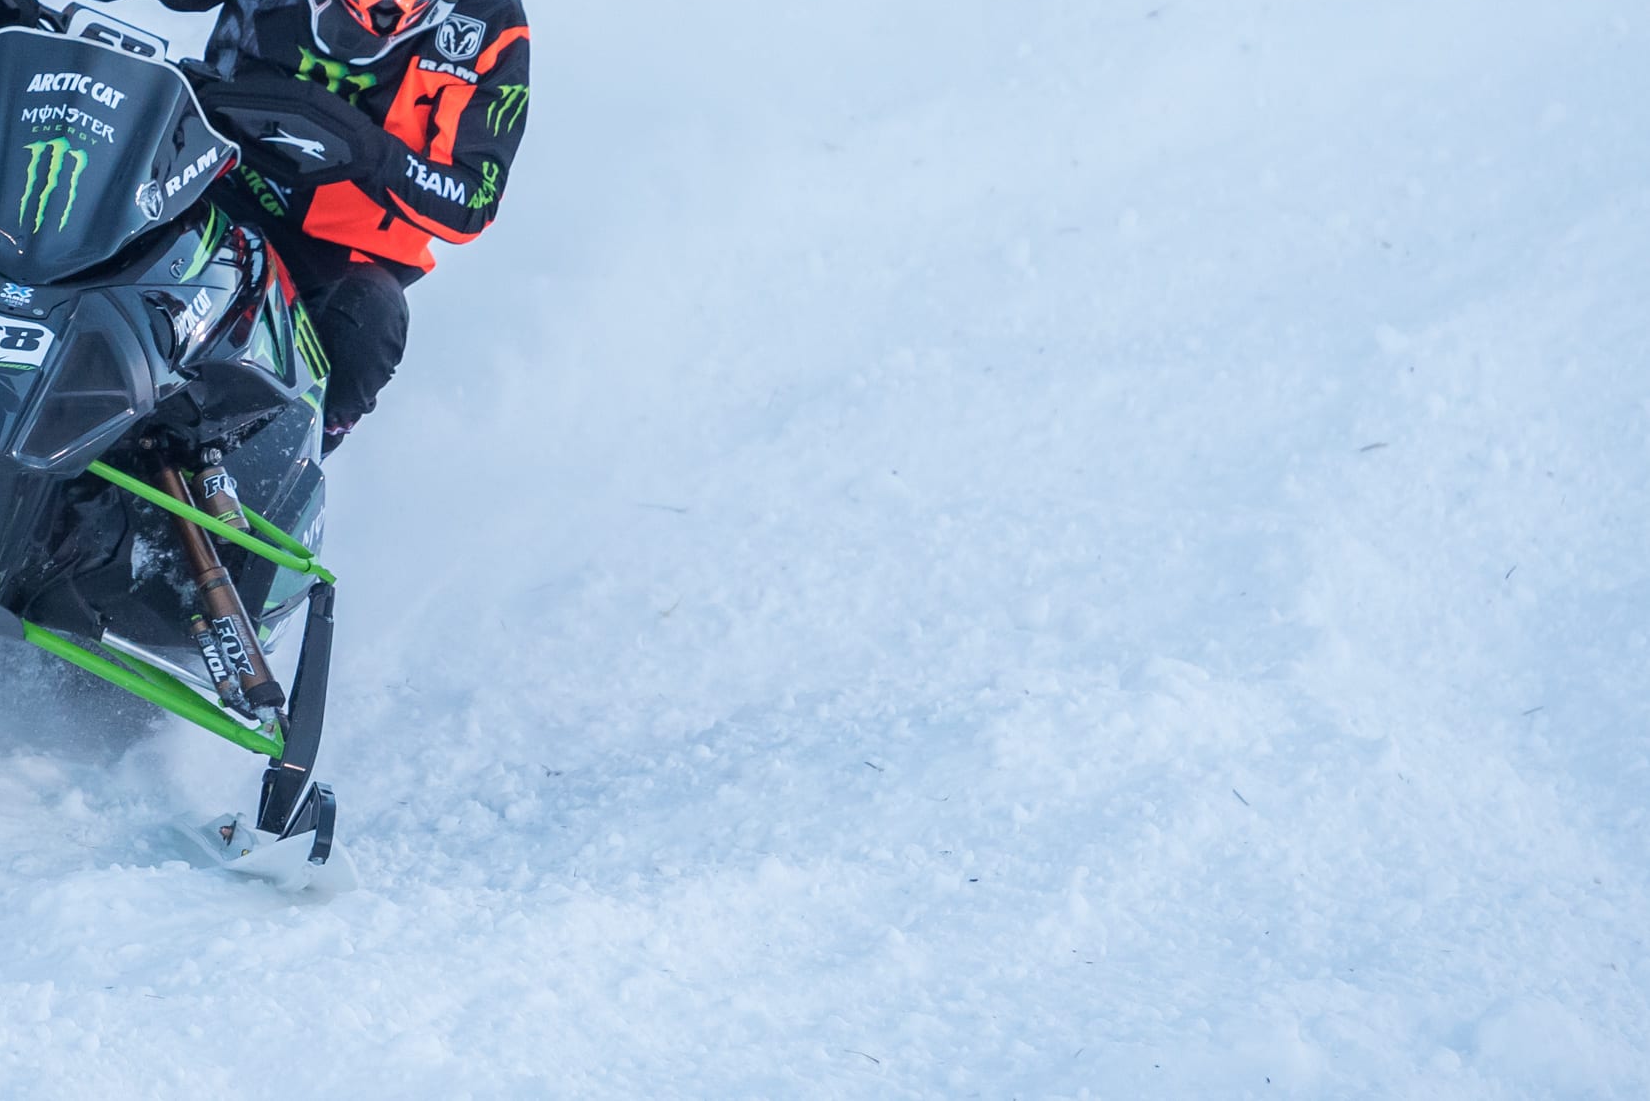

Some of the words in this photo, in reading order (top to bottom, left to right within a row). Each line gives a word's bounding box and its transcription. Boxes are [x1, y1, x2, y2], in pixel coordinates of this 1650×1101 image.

[26, 72, 93, 94] ARCTIC
[91, 82, 125, 110] CAT
[418, 58, 479, 84] RAM
[21, 103, 115, 144] MONSTER
[32, 124, 98, 145] ENERGY
[164, 147, 219, 198] RAM
[405, 154, 466, 206] TEAM
[212, 616, 256, 676] FOX
